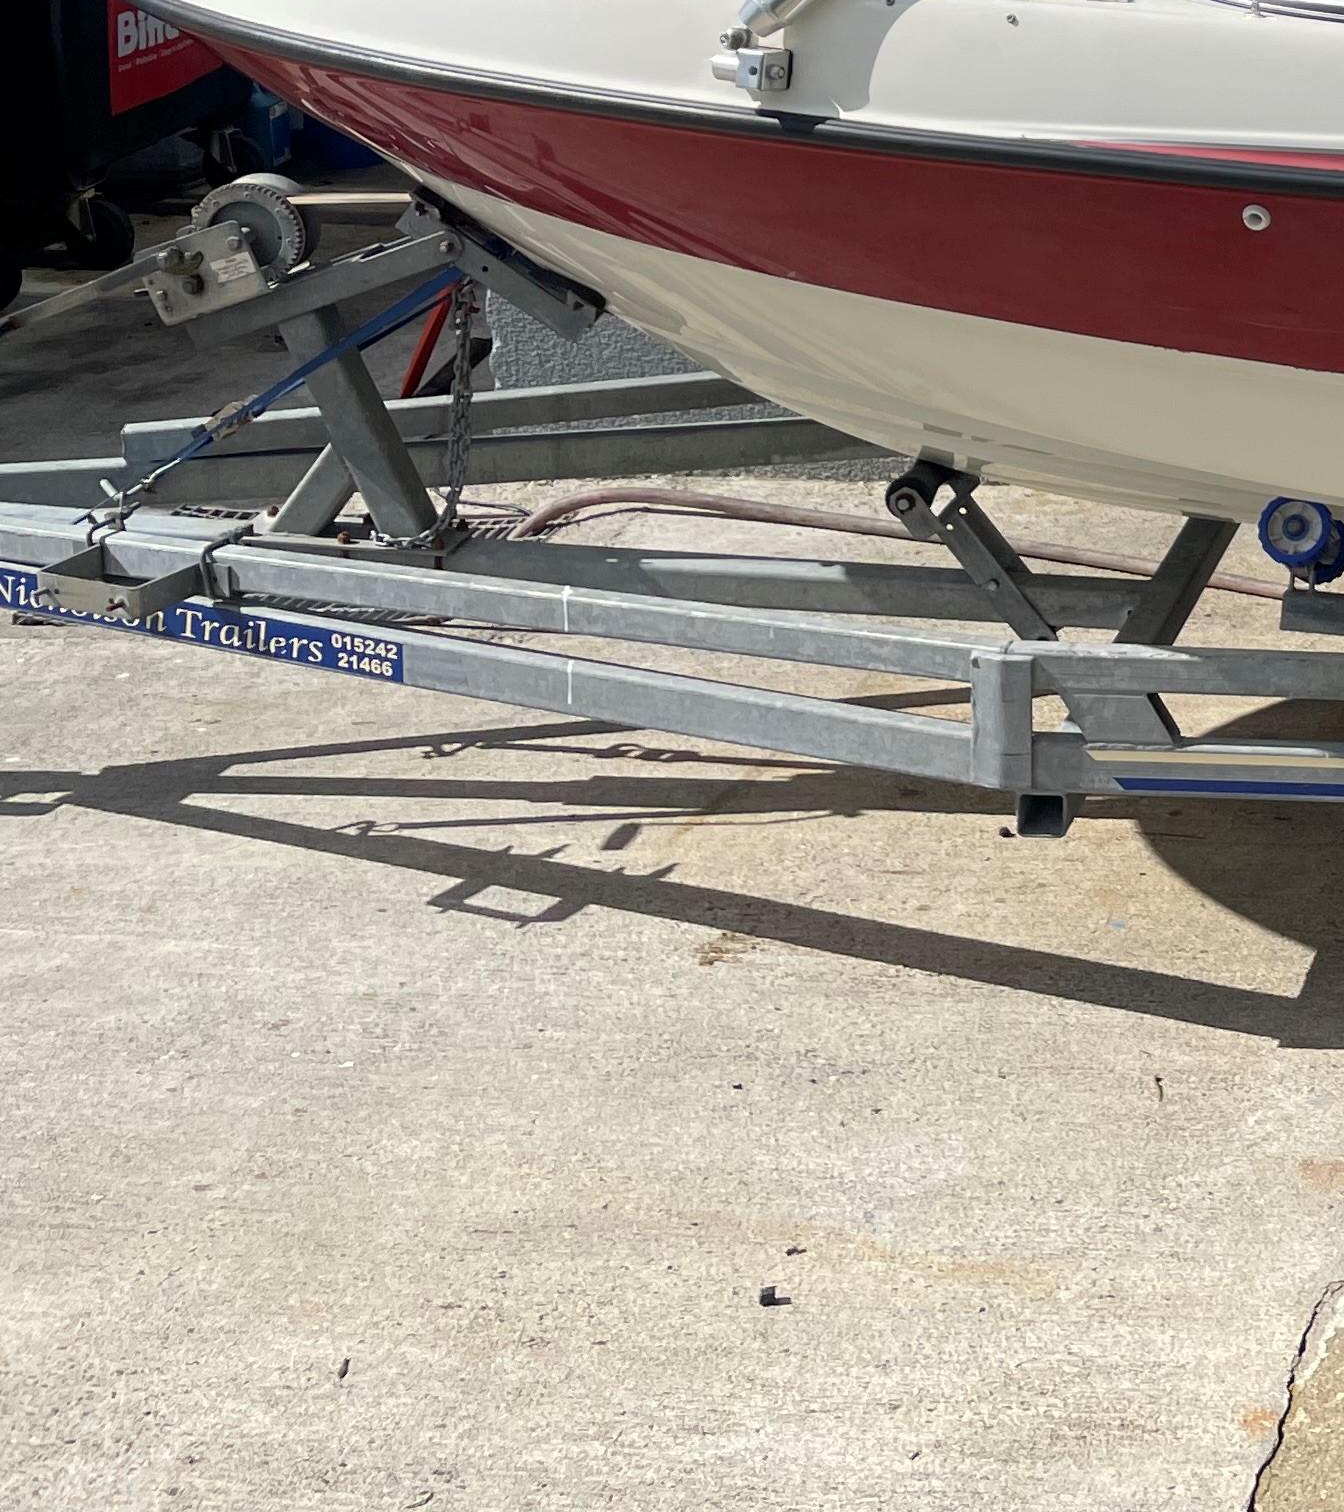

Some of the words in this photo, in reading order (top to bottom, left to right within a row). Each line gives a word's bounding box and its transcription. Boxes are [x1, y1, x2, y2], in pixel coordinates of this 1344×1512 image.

[176, 608, 323, 663] Trailers
[331, 633, 398, 659] 015242
[337, 653, 393, 676] 21466
